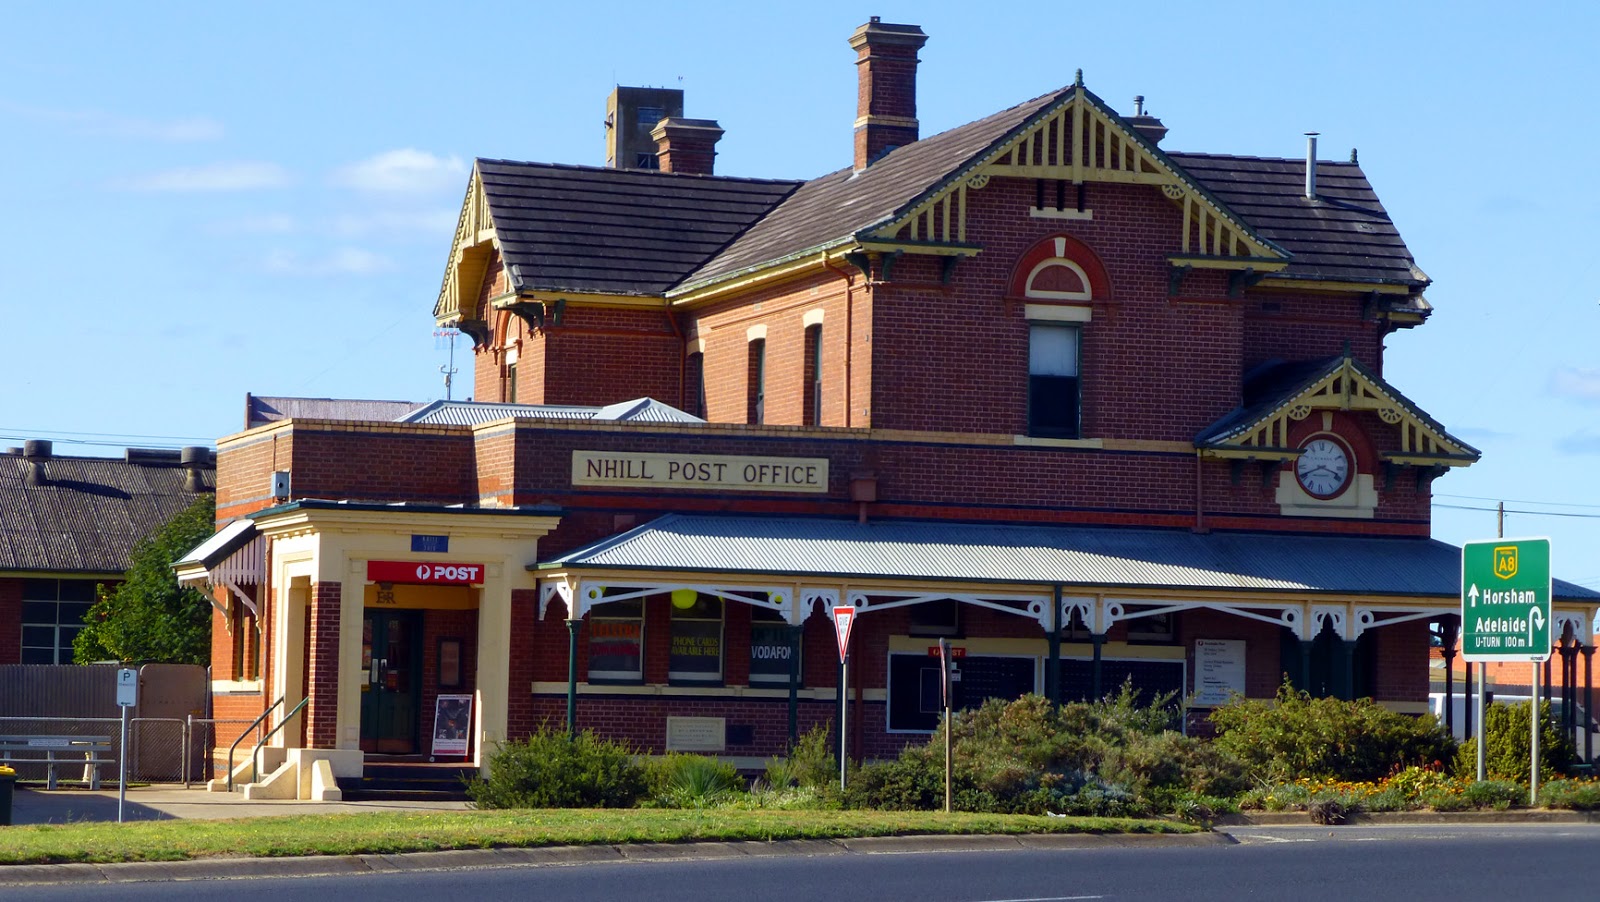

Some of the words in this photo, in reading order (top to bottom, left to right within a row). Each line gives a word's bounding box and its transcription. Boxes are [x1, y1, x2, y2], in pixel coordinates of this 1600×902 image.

[586, 459, 654, 479] NHILL
[668, 461, 727, 482] POST
[743, 464, 818, 484] OFFICE
[1498, 556, 1515, 572] A8
[434, 566, 479, 580] POST
[1483, 588, 1535, 605] Horsham
[1475, 617, 1526, 633] Adelaide
[672, 636, 695, 646] PHONE
[697, 637, 719, 646] CARDS
[1475, 636, 1501, 648] U-TURN
[671, 646, 703, 656] AVAILABLE
[703, 647, 719, 656] HERE
[123, 672, 131, 681] P
